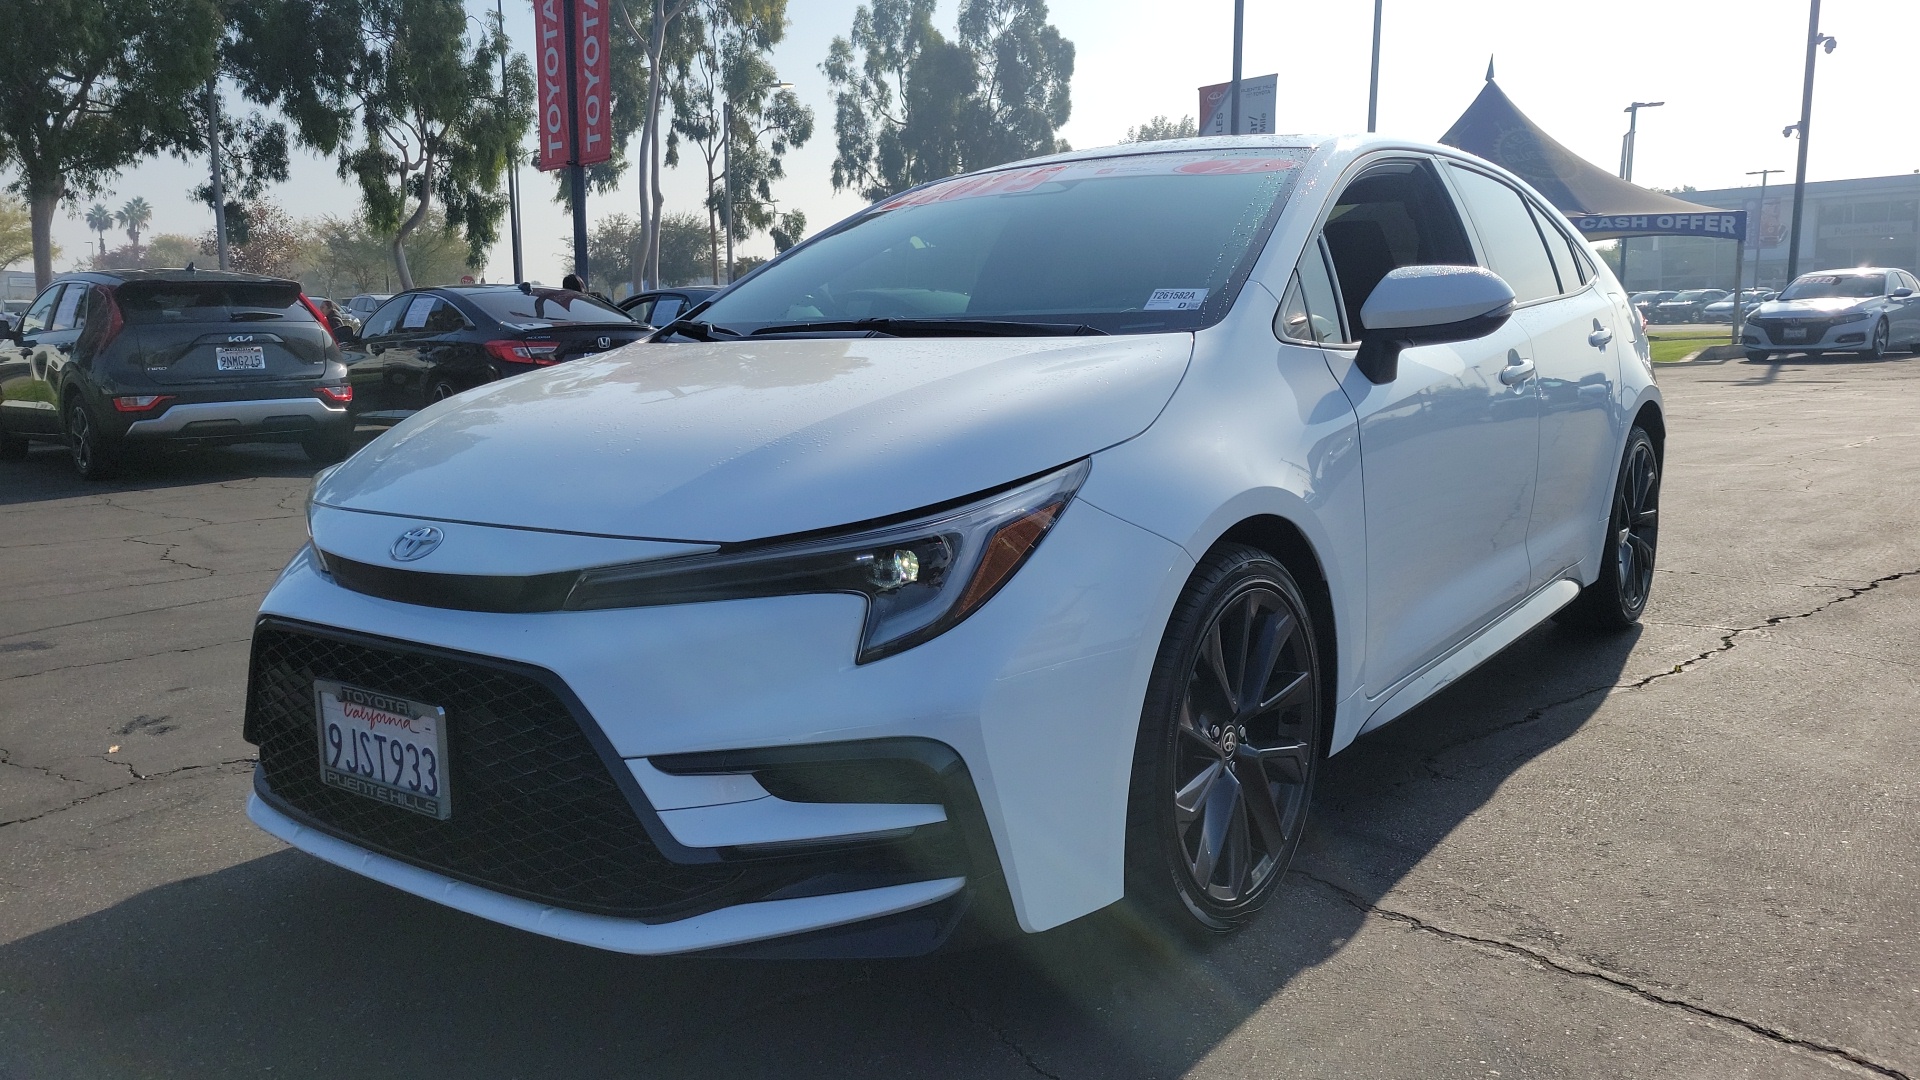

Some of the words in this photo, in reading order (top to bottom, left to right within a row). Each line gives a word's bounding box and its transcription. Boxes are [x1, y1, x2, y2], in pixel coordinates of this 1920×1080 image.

[543, 0, 562, 158] TOYOTA
[1579, 216, 1648, 230] CASH
[1657, 215, 1736, 234] OFFER
[1872, 224, 1896, 233] Hills
[220, 355, 261, 367] 9NMG215
[344, 688, 409, 715] TOYOTA
[344, 702, 420, 734] California
[328, 723, 438, 797] 9JST933
[327, 771, 388, 801] PUENTE
[390, 790, 437, 814] HILLS
